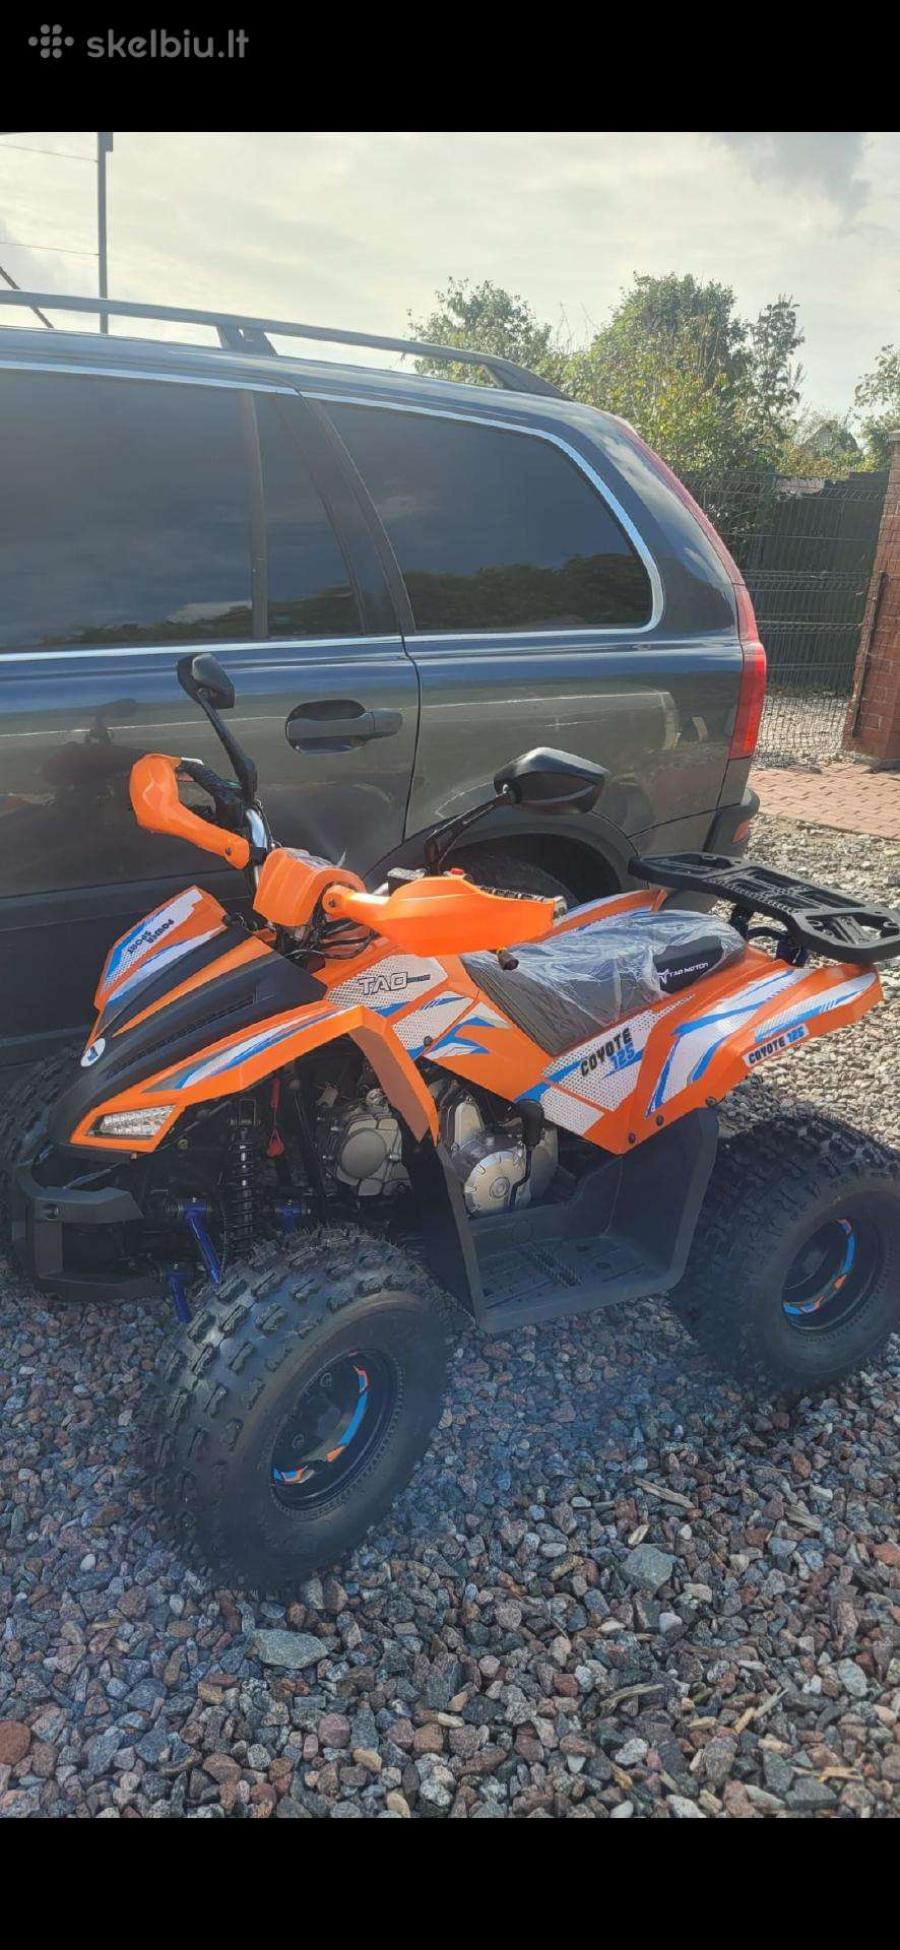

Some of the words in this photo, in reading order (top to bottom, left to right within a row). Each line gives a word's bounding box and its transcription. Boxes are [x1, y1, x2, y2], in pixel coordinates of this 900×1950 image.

[358, 971, 408, 996] TAO
[580, 1027, 632, 1077] COYOTE
[611, 1041, 635, 1070] 125
[748, 1036, 786, 1064] COYOTE
[786, 1026, 805, 1043] 125
